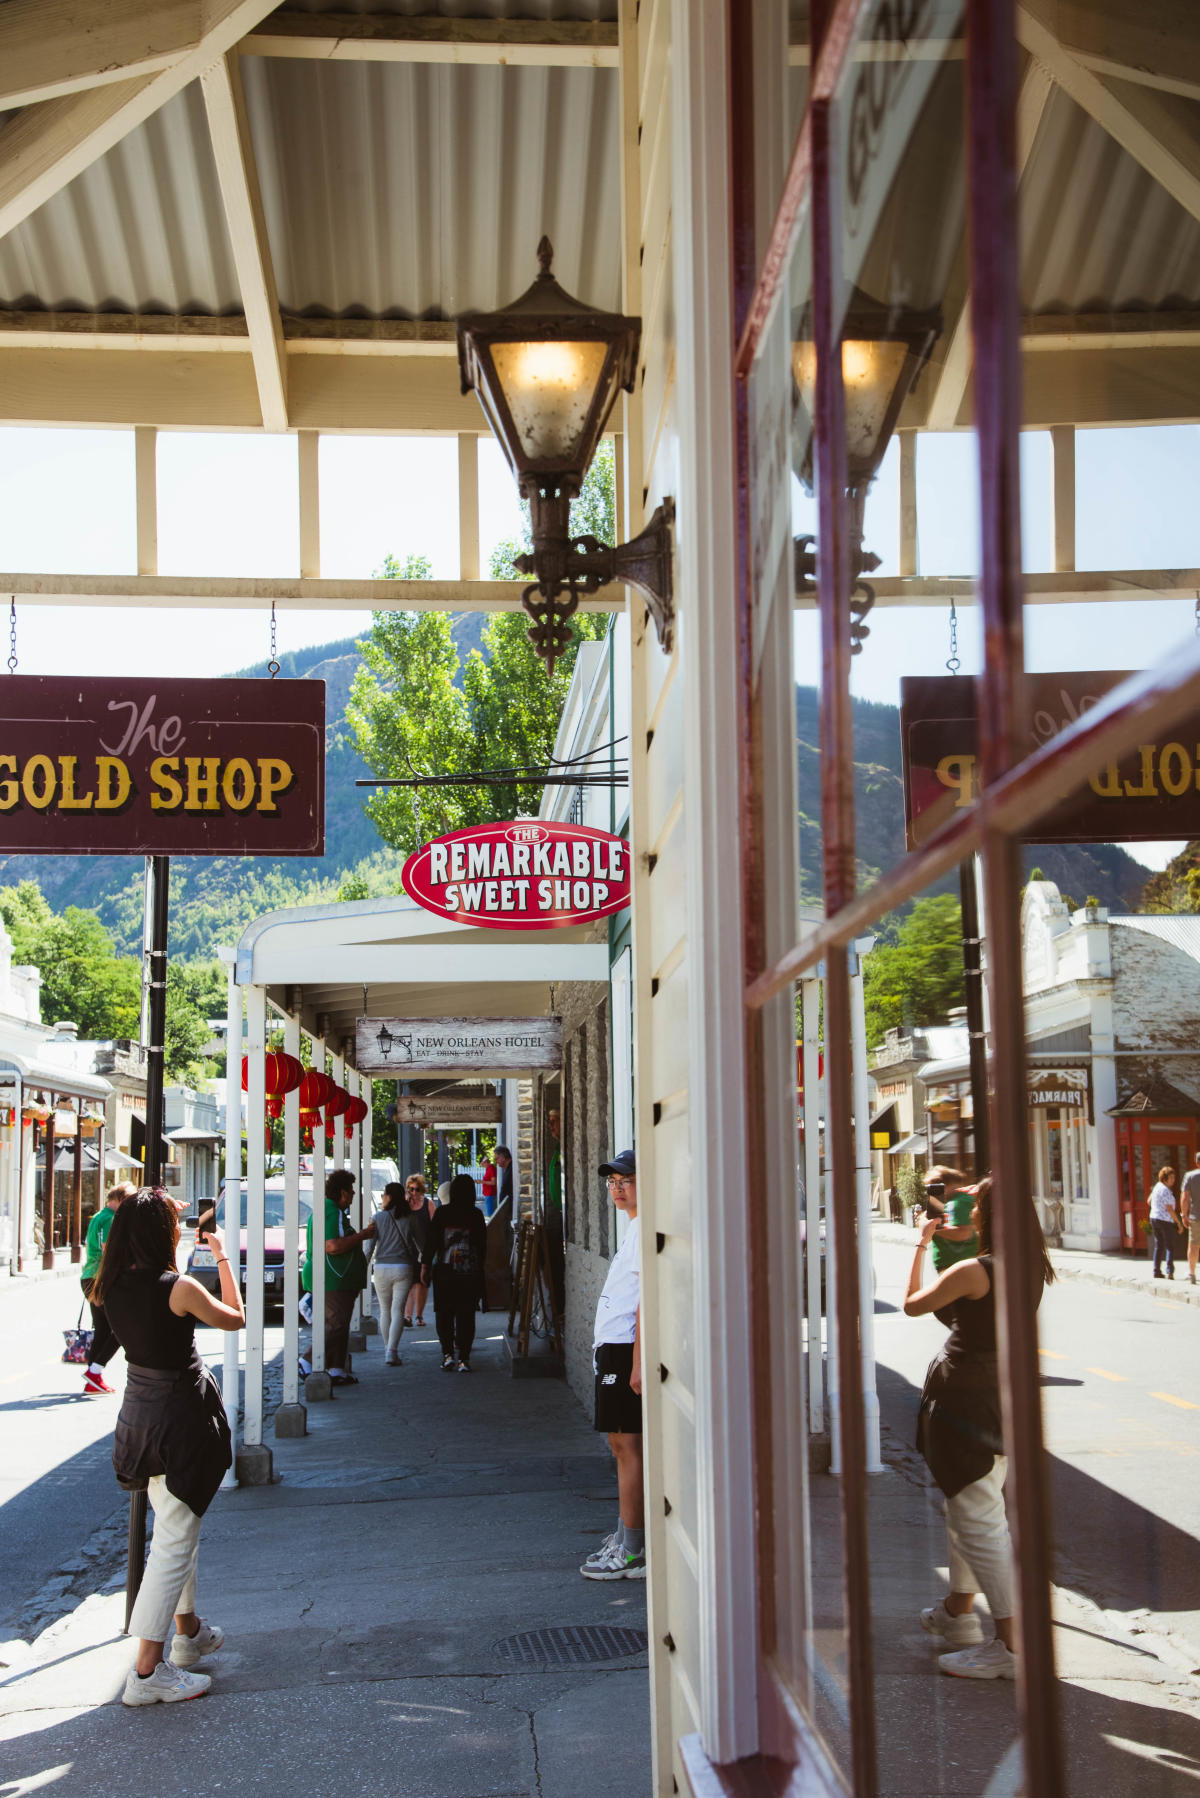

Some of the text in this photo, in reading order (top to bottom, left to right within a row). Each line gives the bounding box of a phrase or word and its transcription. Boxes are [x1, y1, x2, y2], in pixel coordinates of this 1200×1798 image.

[99, 694, 186, 757] The
[0, 753, 296, 813] GOLD SHOP
[512, 827, 541, 841] THE
[429, 840, 626, 886] REMARKABLE
[444, 879, 611, 912] SWEET SHOP
[416, 1037, 545, 1048] NEW ORLEANS HOTEL
